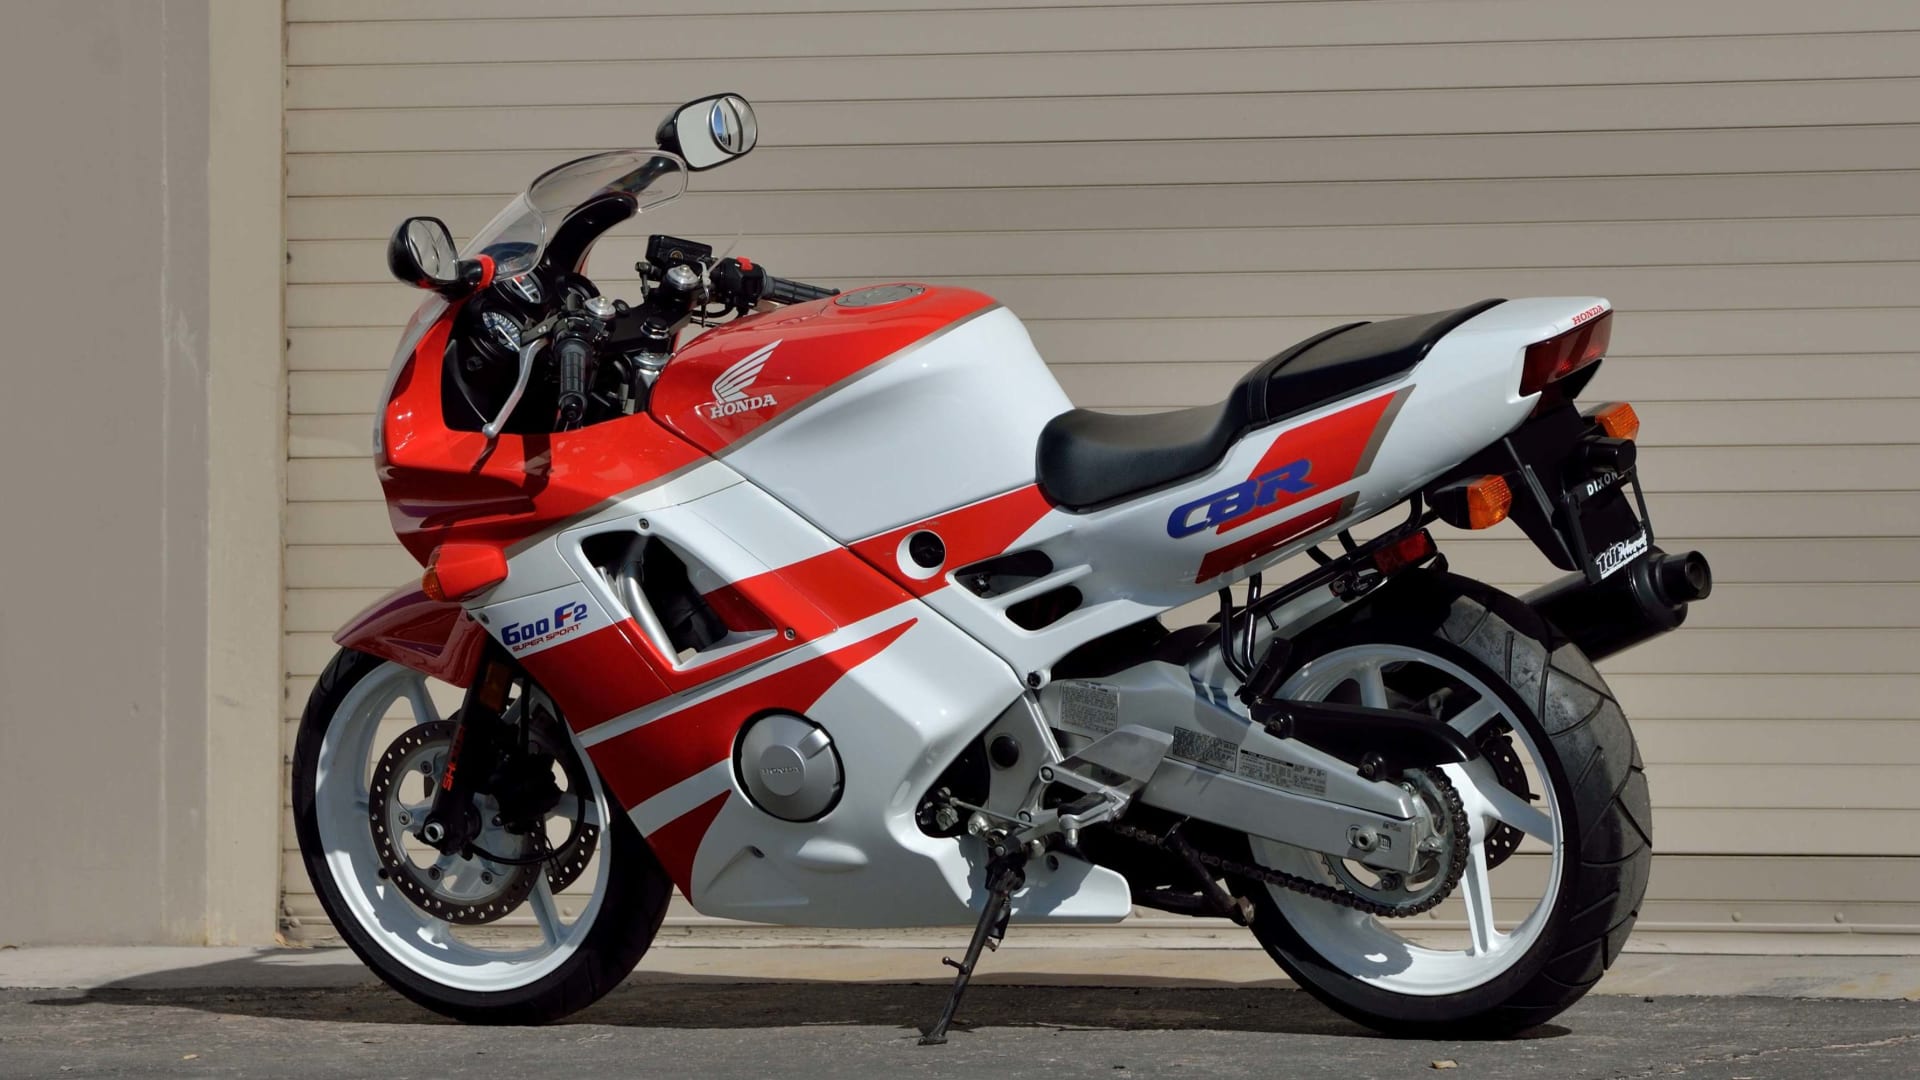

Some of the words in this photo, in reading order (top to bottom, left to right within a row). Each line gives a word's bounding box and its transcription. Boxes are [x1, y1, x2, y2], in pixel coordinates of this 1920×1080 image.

[1572, 304, 1604, 325] HONDA
[710, 394, 778, 419] HONDA
[1167, 458, 1318, 539] CBR
[501, 617, 550, 646] 600
[511, 637, 545, 653] SUPER
[545, 622, 582, 642] SPORT
[442, 725, 465, 791] SHO
[760, 767, 801, 775] HONDA
